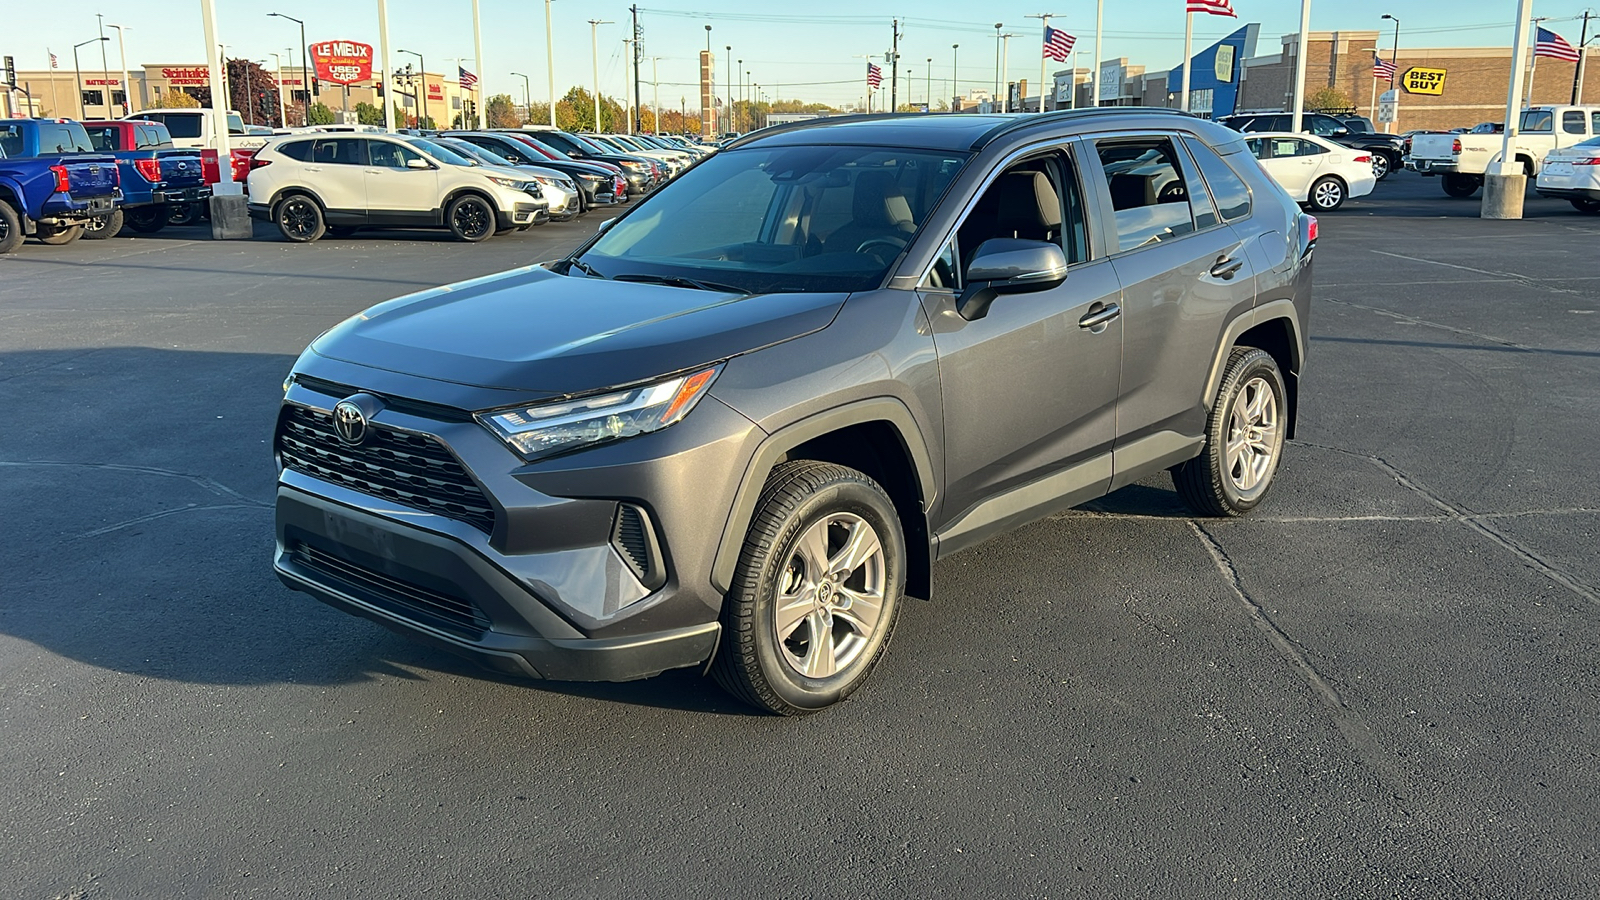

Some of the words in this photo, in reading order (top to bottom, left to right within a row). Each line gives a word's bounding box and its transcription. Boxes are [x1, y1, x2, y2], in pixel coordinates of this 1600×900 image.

[317, 44, 331, 56] LE
[333, 42, 368, 57] MIEUX
[331, 57, 356, 65] Quality
[1218, 51, 1232, 63] BEST
[328, 65, 361, 74] USED
[1217, 63, 1230, 75] BUY
[332, 72, 358, 82] CARS
[1410, 71, 1444, 81] BEST
[1410, 81, 1439, 90] BUY
